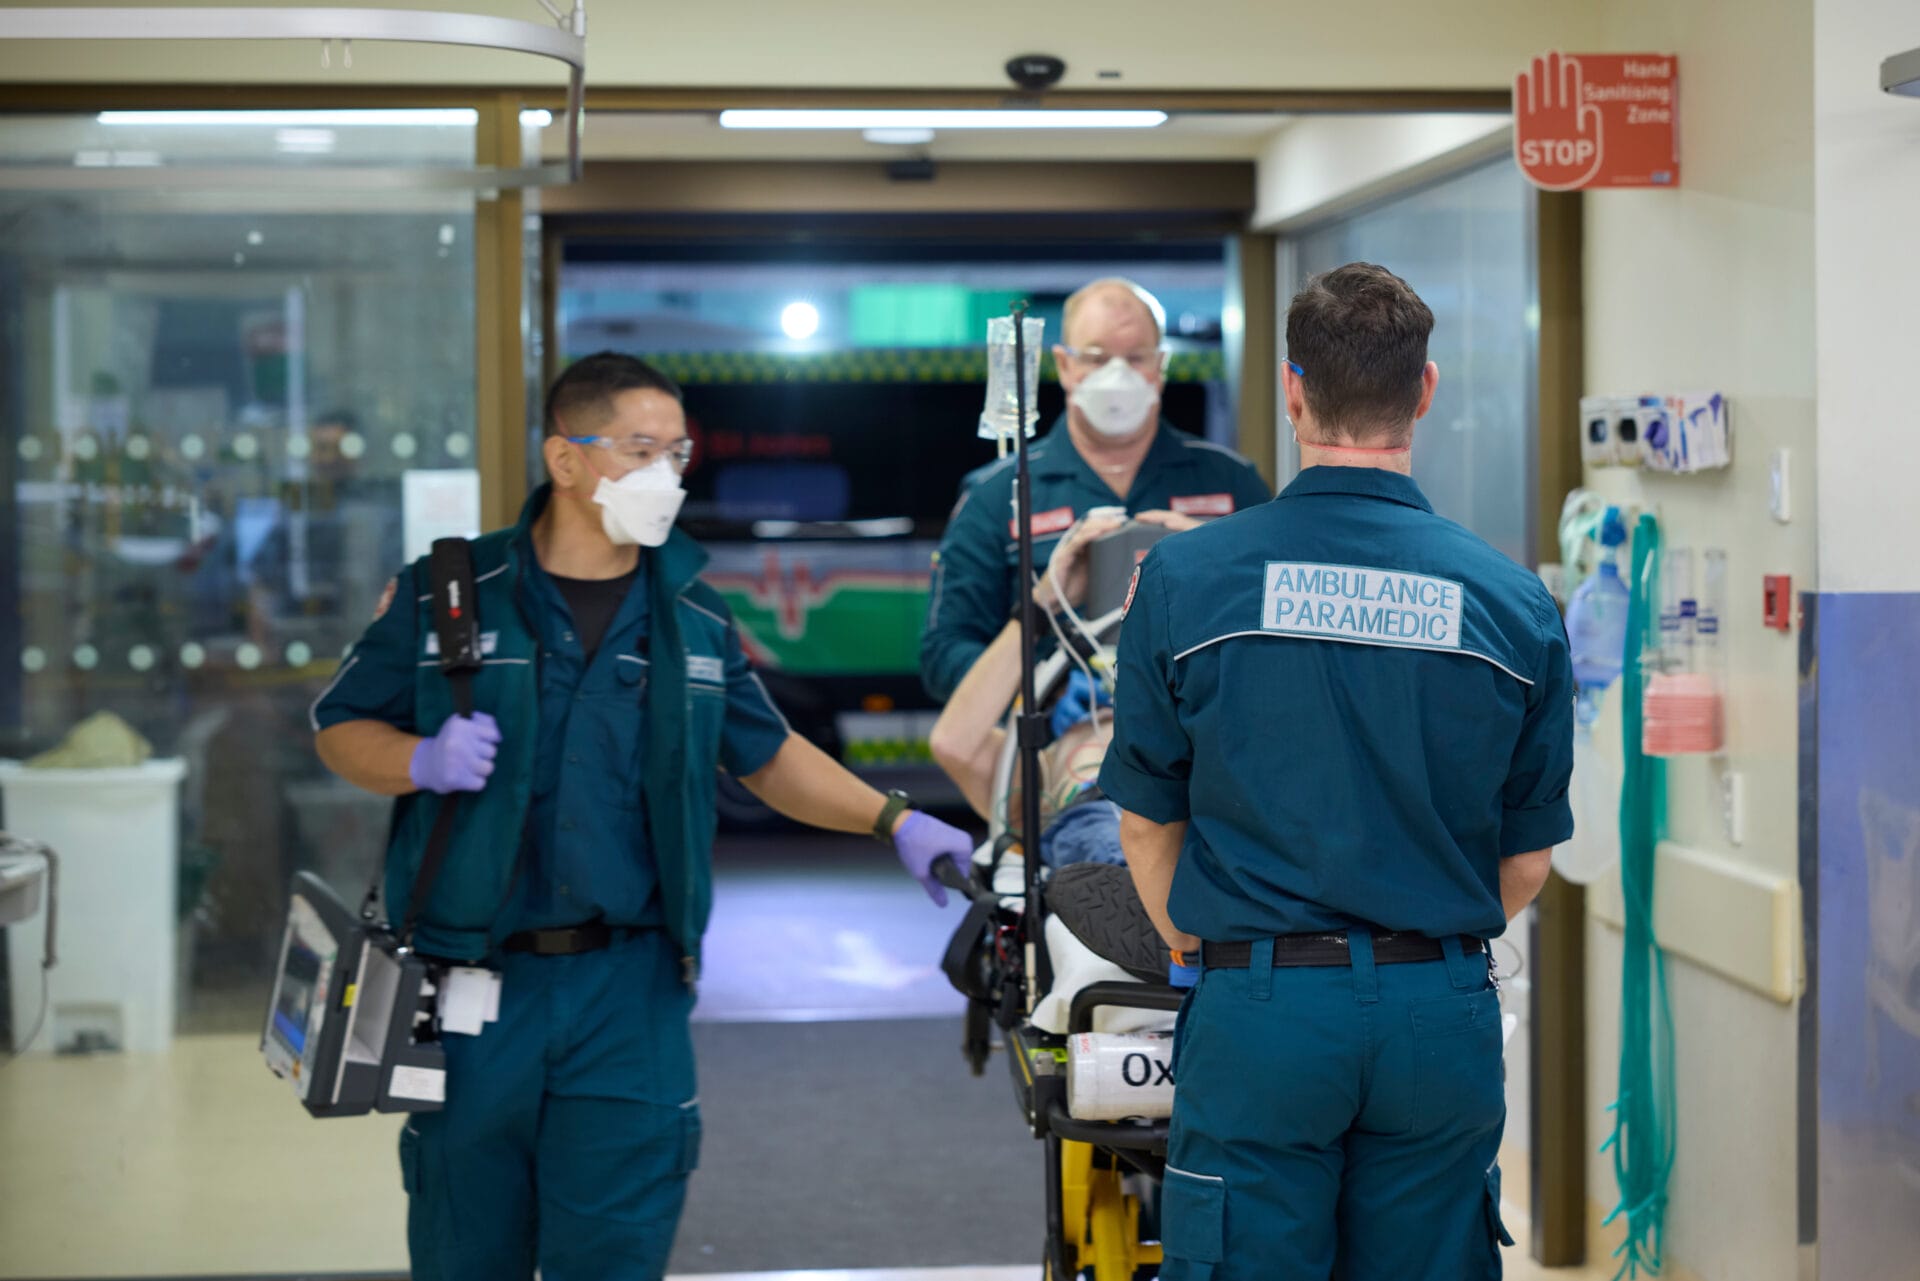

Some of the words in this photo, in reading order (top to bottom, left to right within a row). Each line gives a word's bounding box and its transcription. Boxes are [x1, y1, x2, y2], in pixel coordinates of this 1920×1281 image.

[1623, 60, 1670, 77] Hand
[1583, 82, 1669, 104] Sanitising
[1626, 104, 1670, 124] Zone
[1522, 138, 1595, 166] STOP
[1274, 567, 1454, 610] AMBULANCE
[1275, 597, 1448, 641] PARAMEDIC
